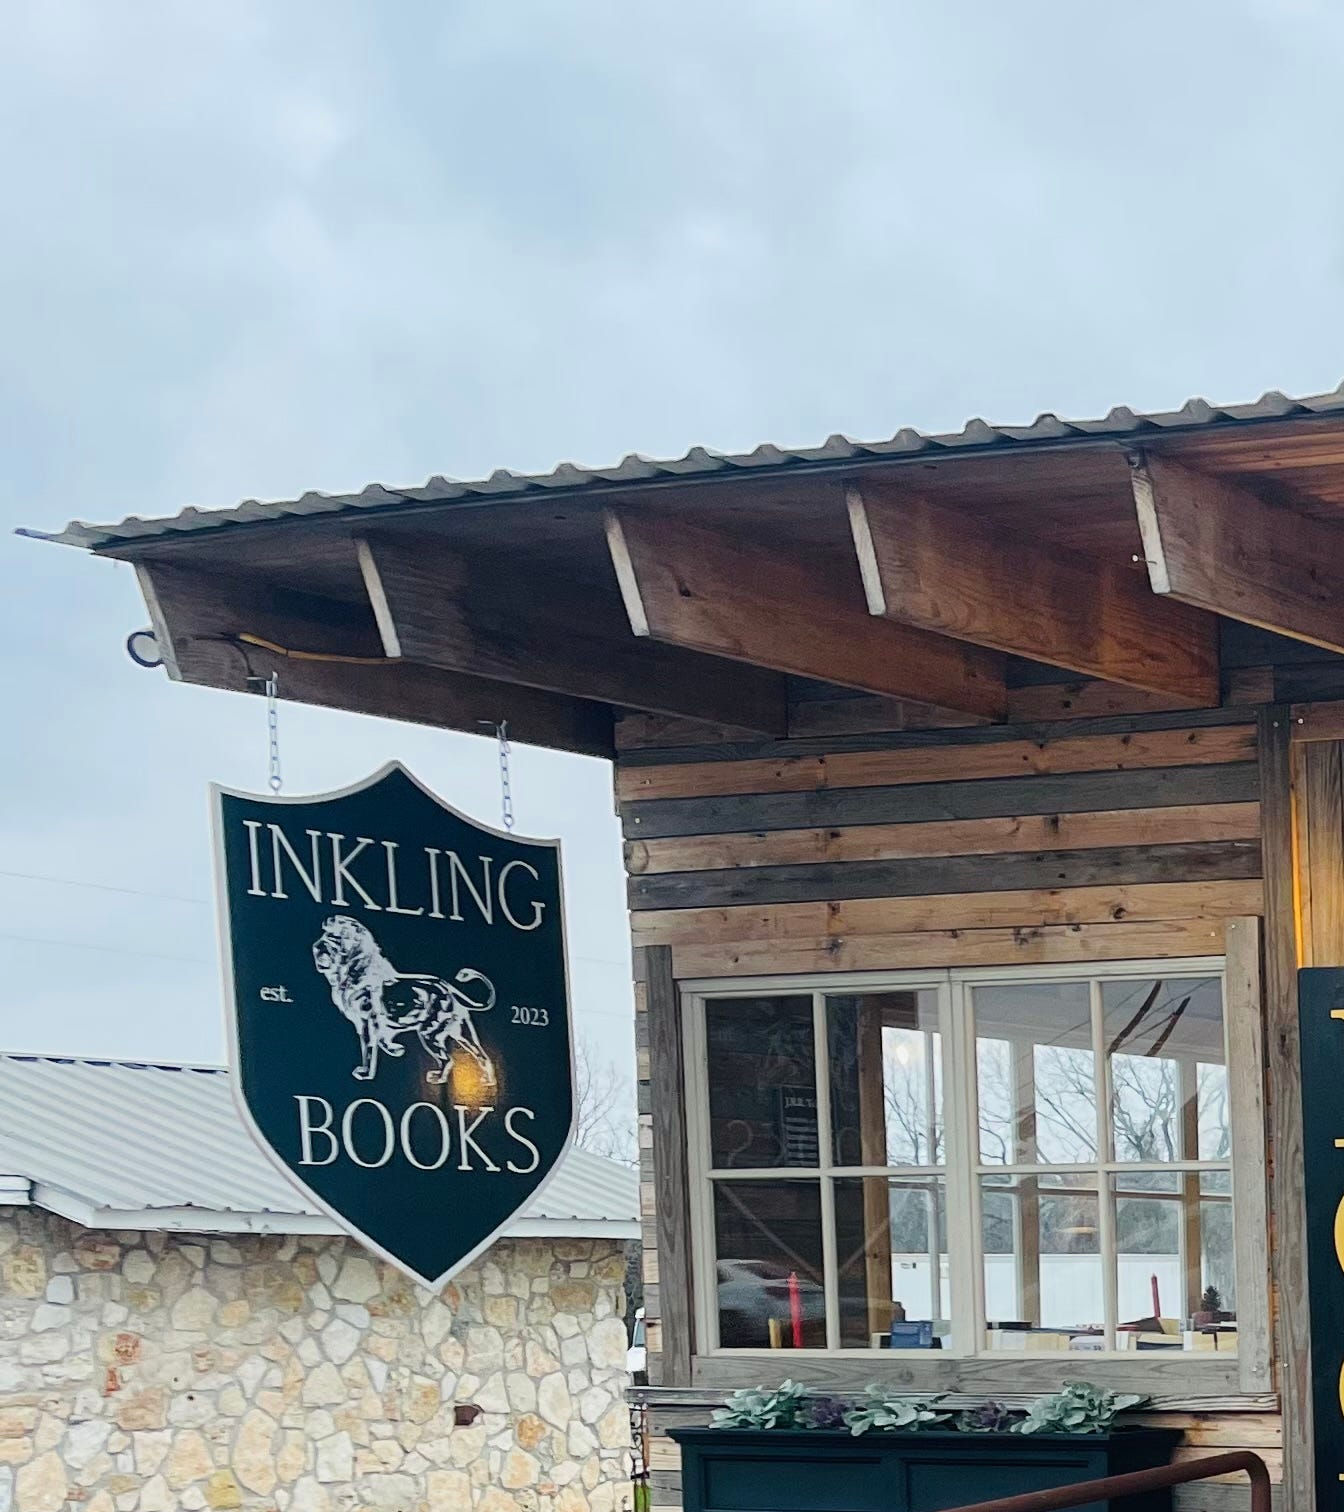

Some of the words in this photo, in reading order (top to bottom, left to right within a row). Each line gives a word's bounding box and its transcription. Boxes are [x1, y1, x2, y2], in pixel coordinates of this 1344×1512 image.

[242, 819, 546, 931] INKLING
[260, 984, 293, 1003] est.
[511, 1006, 549, 1027] 2023
[292, 1095, 542, 1174] BOOKS
